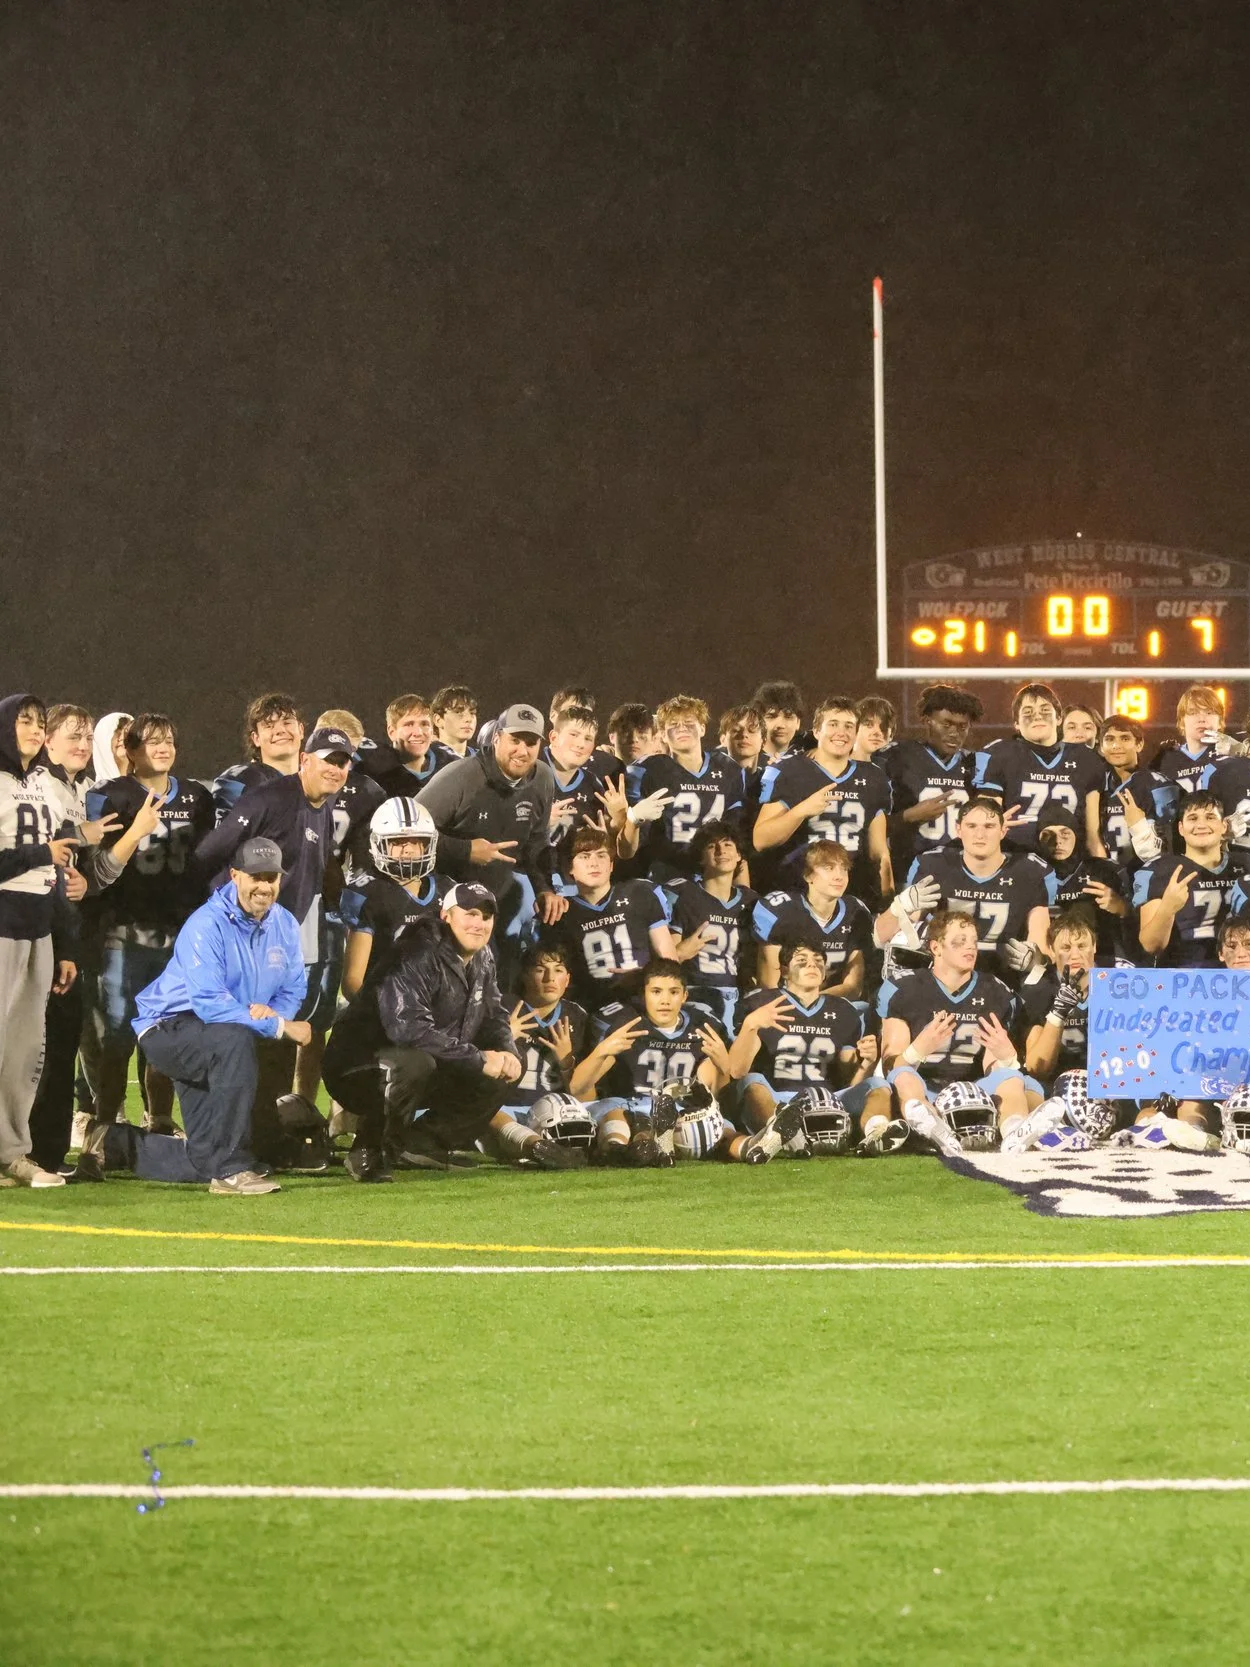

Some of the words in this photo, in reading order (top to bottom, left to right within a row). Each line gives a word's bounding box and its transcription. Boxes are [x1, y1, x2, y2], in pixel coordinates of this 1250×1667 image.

[975, 548, 1024, 569] WEST
[1032, 543, 1096, 562] MORRIS
[1103, 545, 1181, 569] CENTRAL
[918, 602, 1009, 618] WOLFPACK
[1156, 601, 1227, 617] GUEST
[1190, 619, 1214, 652] 7
[1177, 765, 1208, 777] WOLFPA
[927, 777, 965, 787] WOLFPACK
[1030, 773, 1070, 782] WOLFPACK
[680, 783, 719, 792] WOLFPACK
[12, 793, 45, 802] WOLFPACK
[825, 791, 859, 800] OLFPACK
[1018, 781, 1077, 822] 73
[158, 811, 189, 819] LFPACK
[807, 801, 865, 851] 52
[1199, 880, 1237, 889] WOLFPAC
[954, 889, 1003, 900] WOLFPACK
[581, 912, 626, 931] WOLFPACK
[709, 914, 738, 926] WOLFPA
[581, 923, 639, 979] 81
[1109, 972, 1150, 1000] GO
[1171, 973, 1250, 1000] PACK
[1094, 1005, 1241, 1039] Undefeated
[789, 1025, 831, 1035] WOLFPACK
[649, 1041, 691, 1050] WOLFPACK
